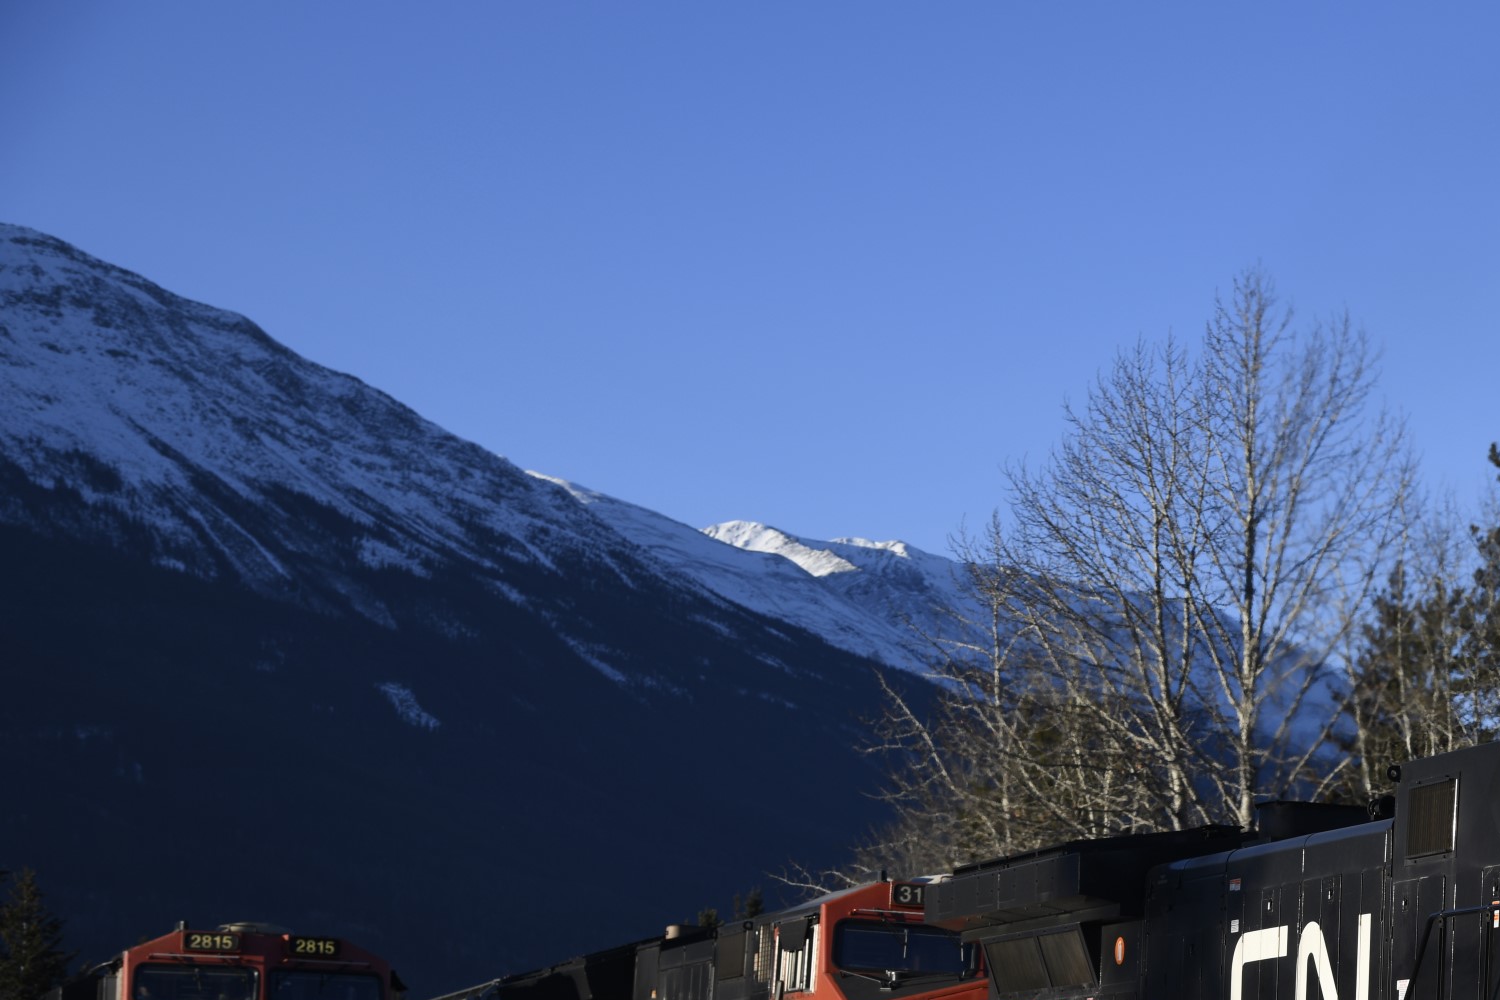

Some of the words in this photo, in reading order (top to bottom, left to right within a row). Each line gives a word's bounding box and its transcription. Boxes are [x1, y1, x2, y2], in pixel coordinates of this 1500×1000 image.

[899, 886, 922, 903] 31
[190, 934, 233, 950] 2815
[295, 939, 336, 955] 2815
